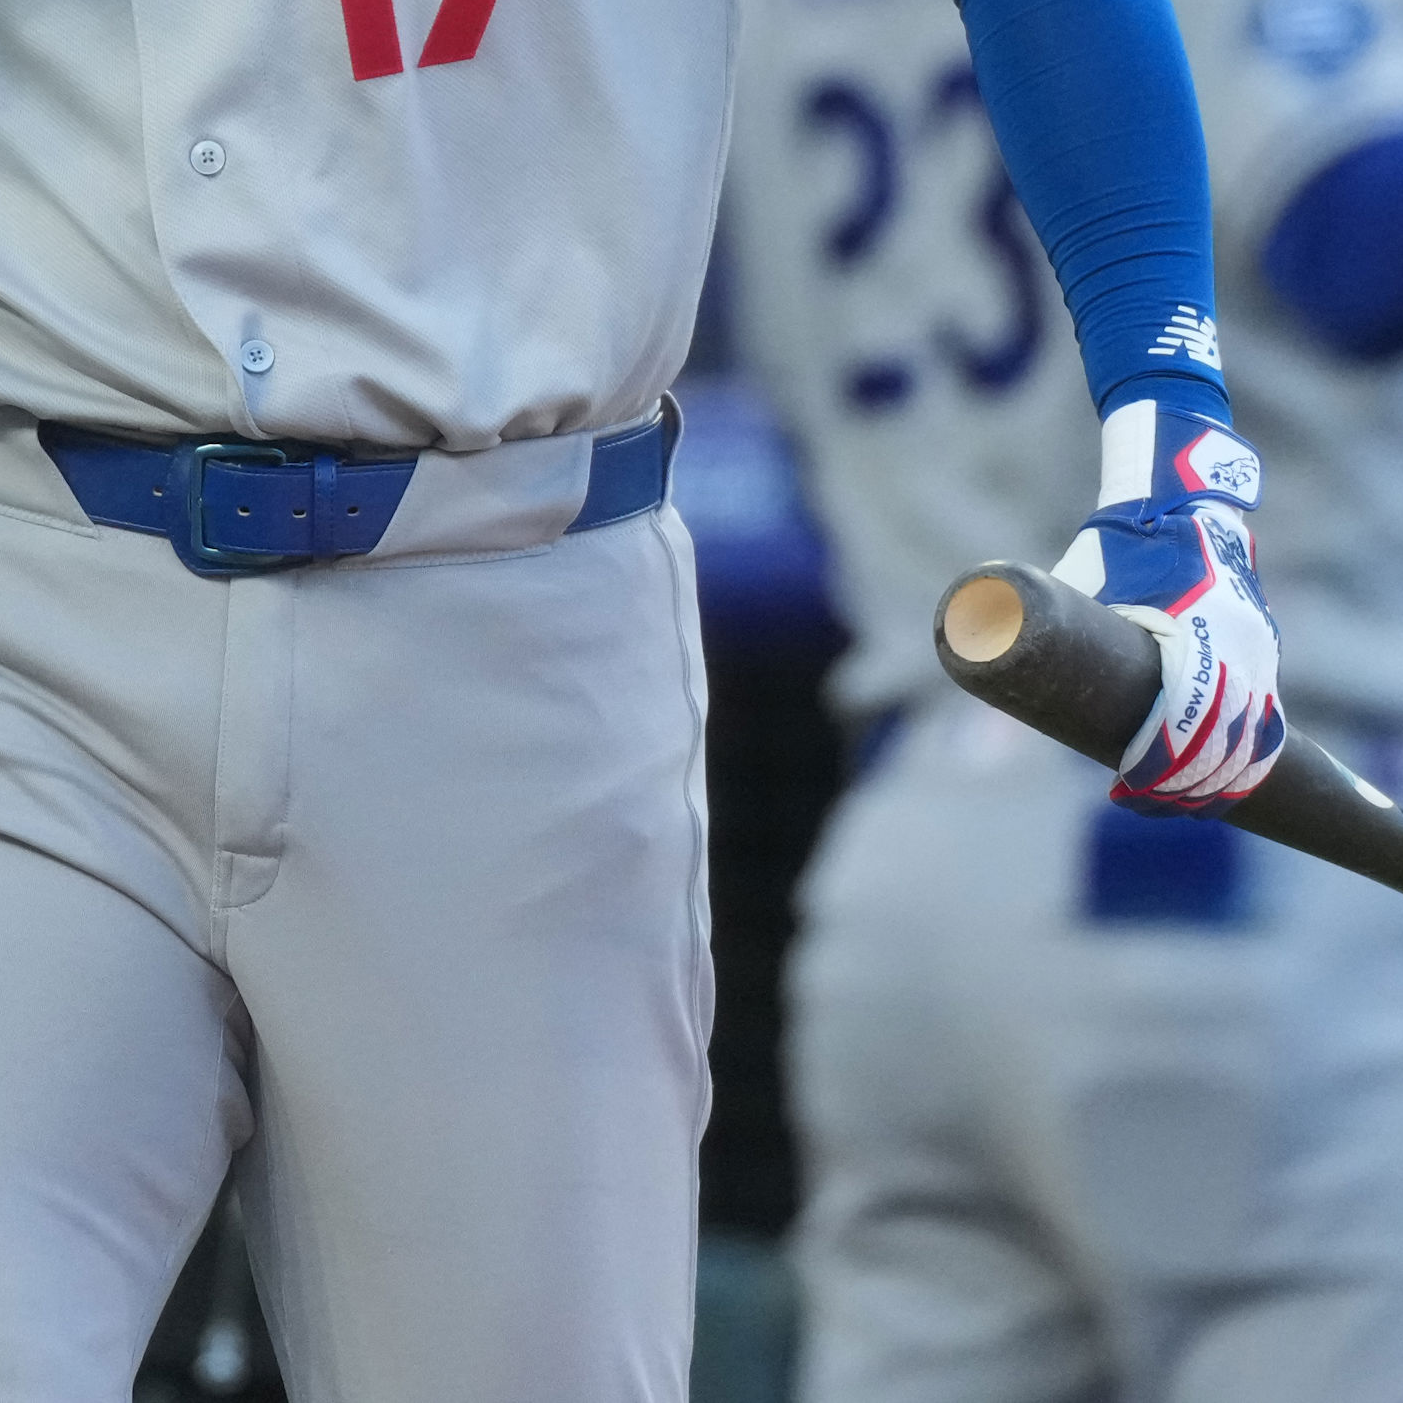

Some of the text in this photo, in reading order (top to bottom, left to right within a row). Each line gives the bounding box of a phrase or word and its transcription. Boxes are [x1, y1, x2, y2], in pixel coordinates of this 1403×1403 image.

[798, 55, 1048, 408] 23
[1175, 615, 1213, 734] new balance
